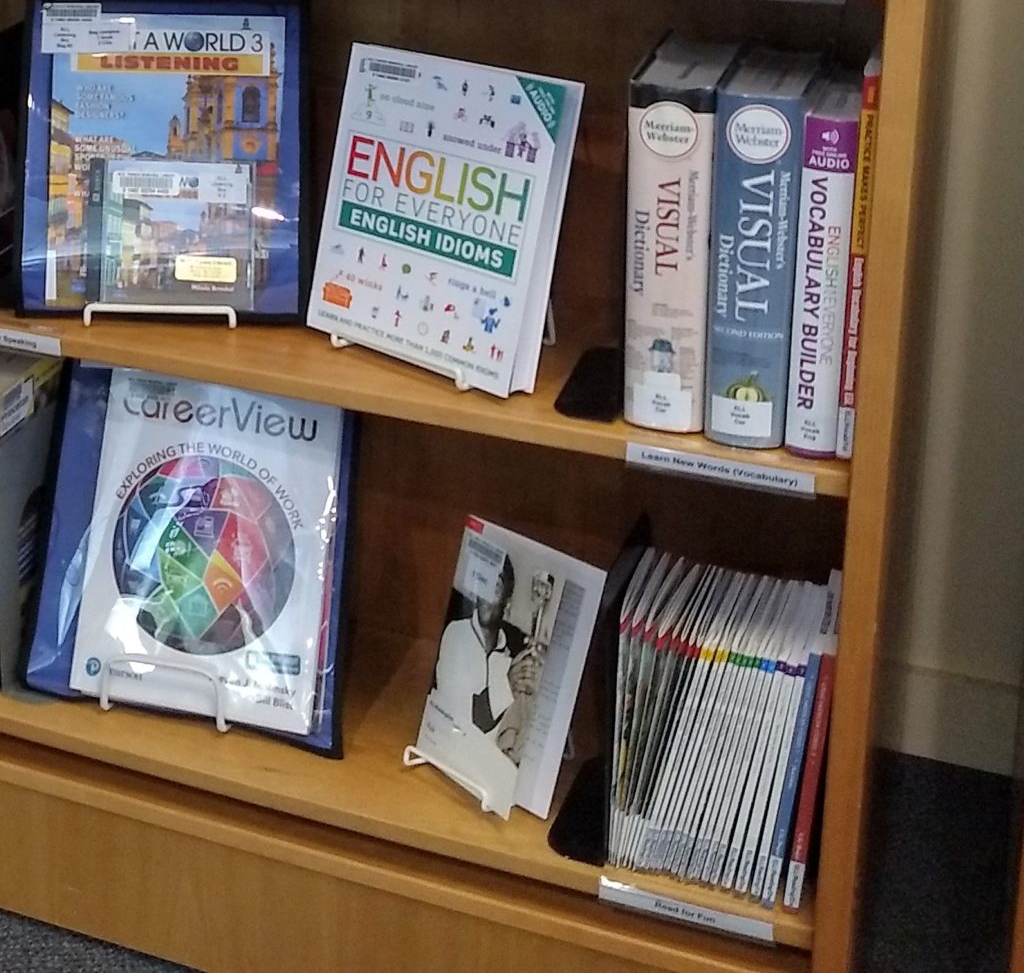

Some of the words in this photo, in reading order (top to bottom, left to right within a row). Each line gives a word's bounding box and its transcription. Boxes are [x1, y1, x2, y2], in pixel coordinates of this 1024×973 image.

[100, 55, 239, 71] LISTENING
[144, 33, 159, 51] A
[251, 33, 263, 52] 3
[365, 110, 372, 120] 9
[443, 133, 475, 148] snowed
[477, 141, 502, 155] under
[646, 131, 690, 145] Webster
[734, 134, 780, 148] Webster
[346, 134, 531, 223] ENGLISH
[809, 155, 850, 169] AUDIO
[343, 178, 385, 207] FOR
[395, 193, 523, 246] EVERYONE
[350, 208, 431, 246] ENGLISH
[435, 232, 504, 269] IDIOMS
[655, 178, 681, 276] VISUAL
[630, 208, 651, 295] Dictionary
[733, 169, 775, 323] VISUAL
[802, 176, 828, 320] VOCABULARY
[824, 225, 841, 289] ENGLISH
[715, 233, 735, 327] Dictionary
[3, 334, 37, 349] Speaking
[797, 323, 819, 410] BUILDER
[115, 445, 177, 500] EXPLORING
[178, 442, 205, 453] THE
[208, 444, 258, 471] WORLD
[258, 467, 278, 487] OF
[275, 484, 304, 530] WORK
[641, 451, 670, 463] Learn
[672, 456, 694, 467] New
[696, 461, 730, 474] Words
[733, 468, 798, 487] (Vocabulary)
[654, 901, 680, 914] Read
[680, 907, 695, 918] for
[697, 911, 716, 924] Fun
